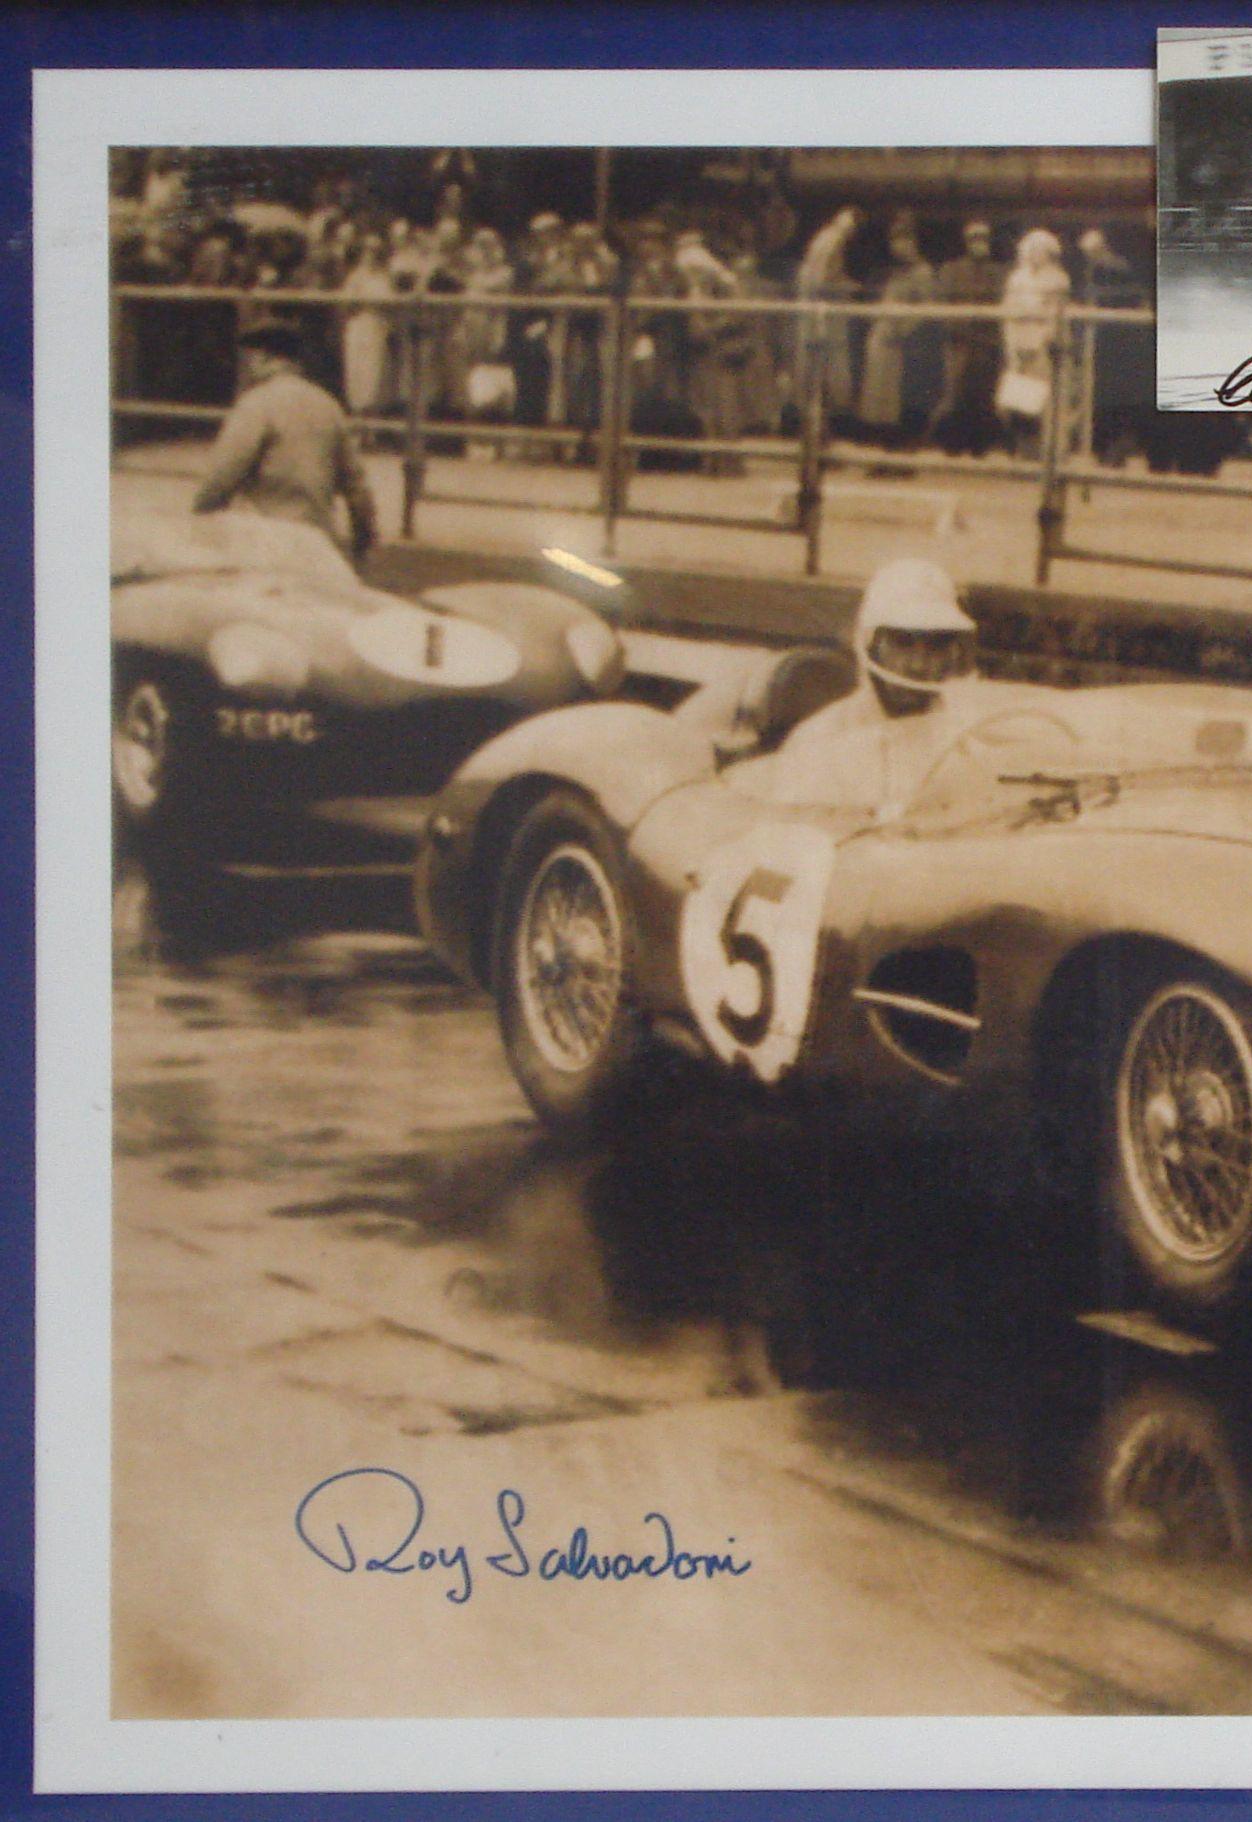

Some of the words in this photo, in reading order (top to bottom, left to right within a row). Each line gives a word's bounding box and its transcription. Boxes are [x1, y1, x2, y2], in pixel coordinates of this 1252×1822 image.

[425, 622, 444, 669] 1
[716, 866, 795, 1050] 5
[295, 1467, 473, 1605] Roy
